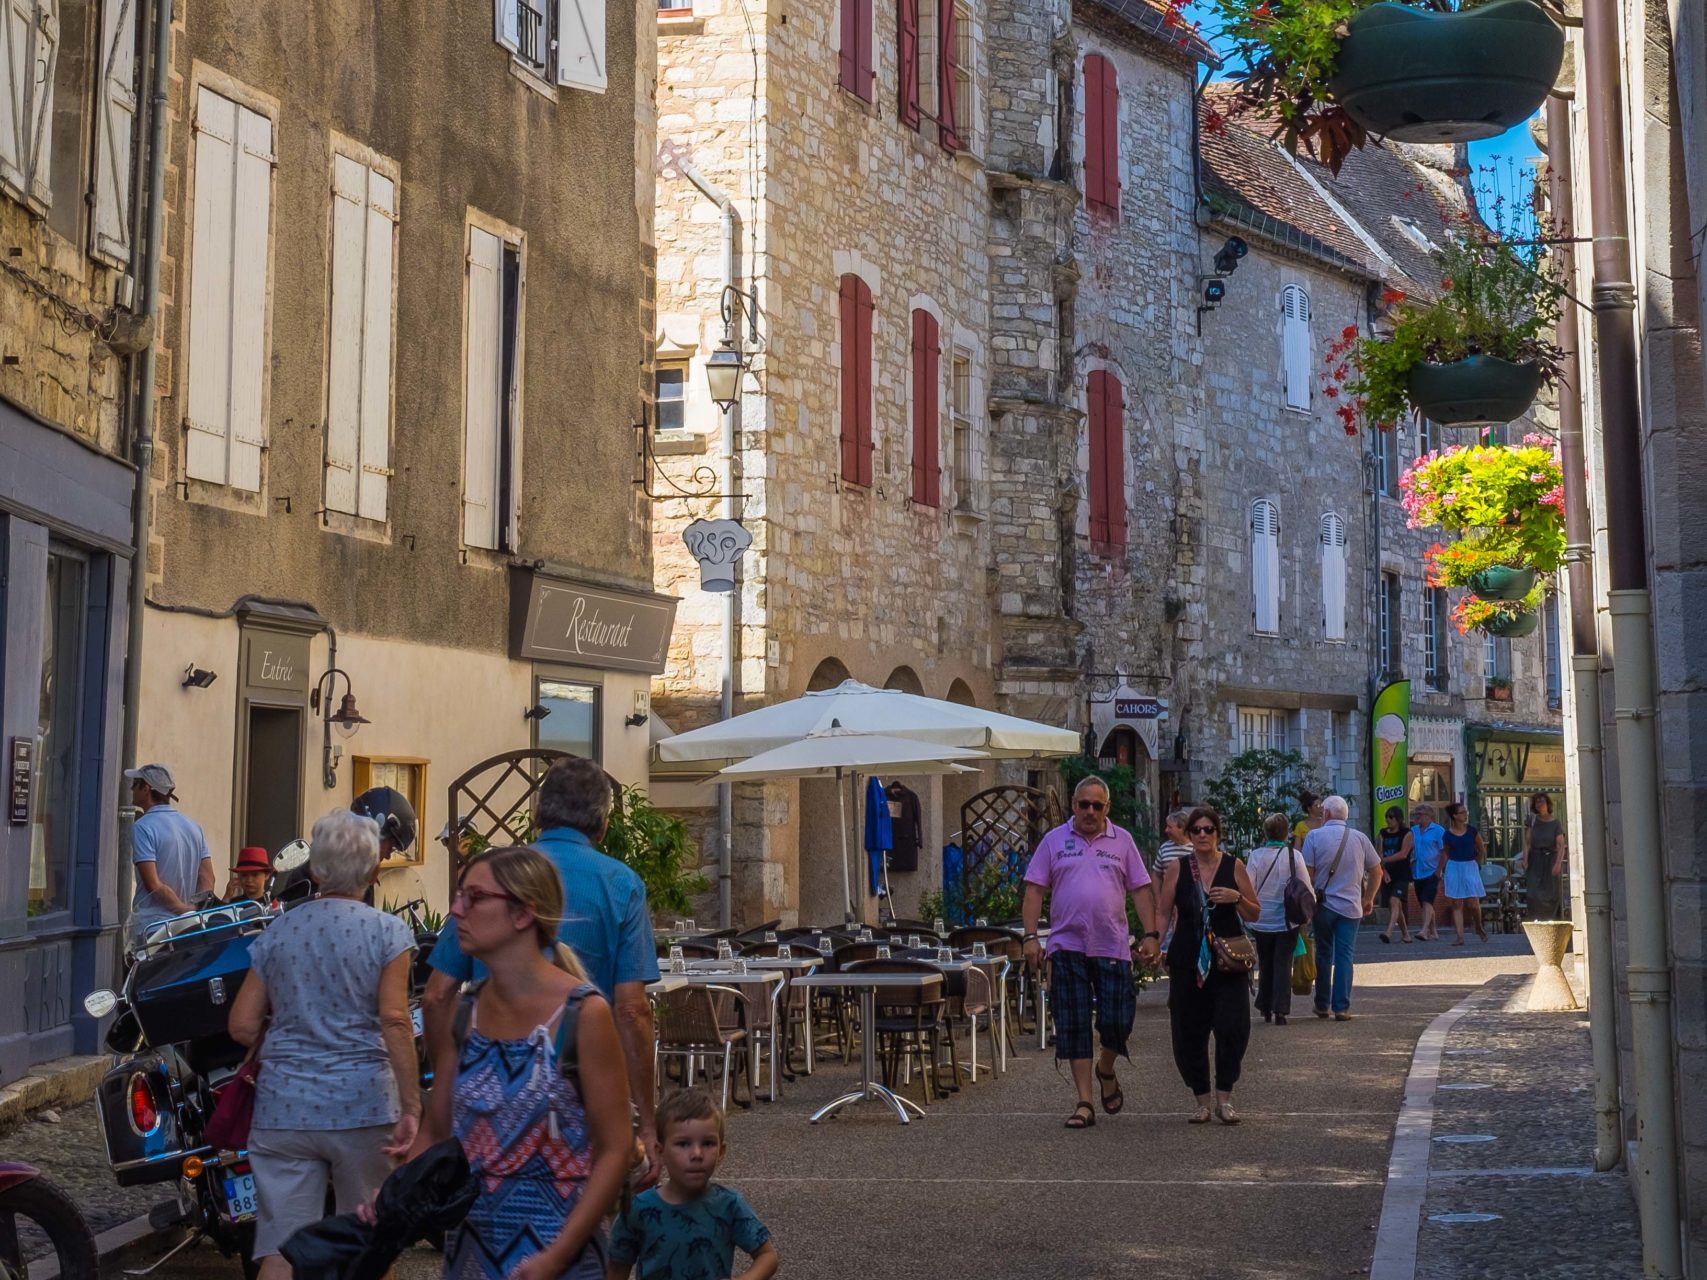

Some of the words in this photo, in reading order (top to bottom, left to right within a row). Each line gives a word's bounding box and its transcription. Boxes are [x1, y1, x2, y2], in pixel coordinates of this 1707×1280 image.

[565, 597, 636, 655] Restaurant
[261, 650, 294, 681] Entrée
[1116, 703, 1158, 715] CAHORS
[1376, 785, 1403, 802] Glaces
[1057, 848, 1084, 860] Break
